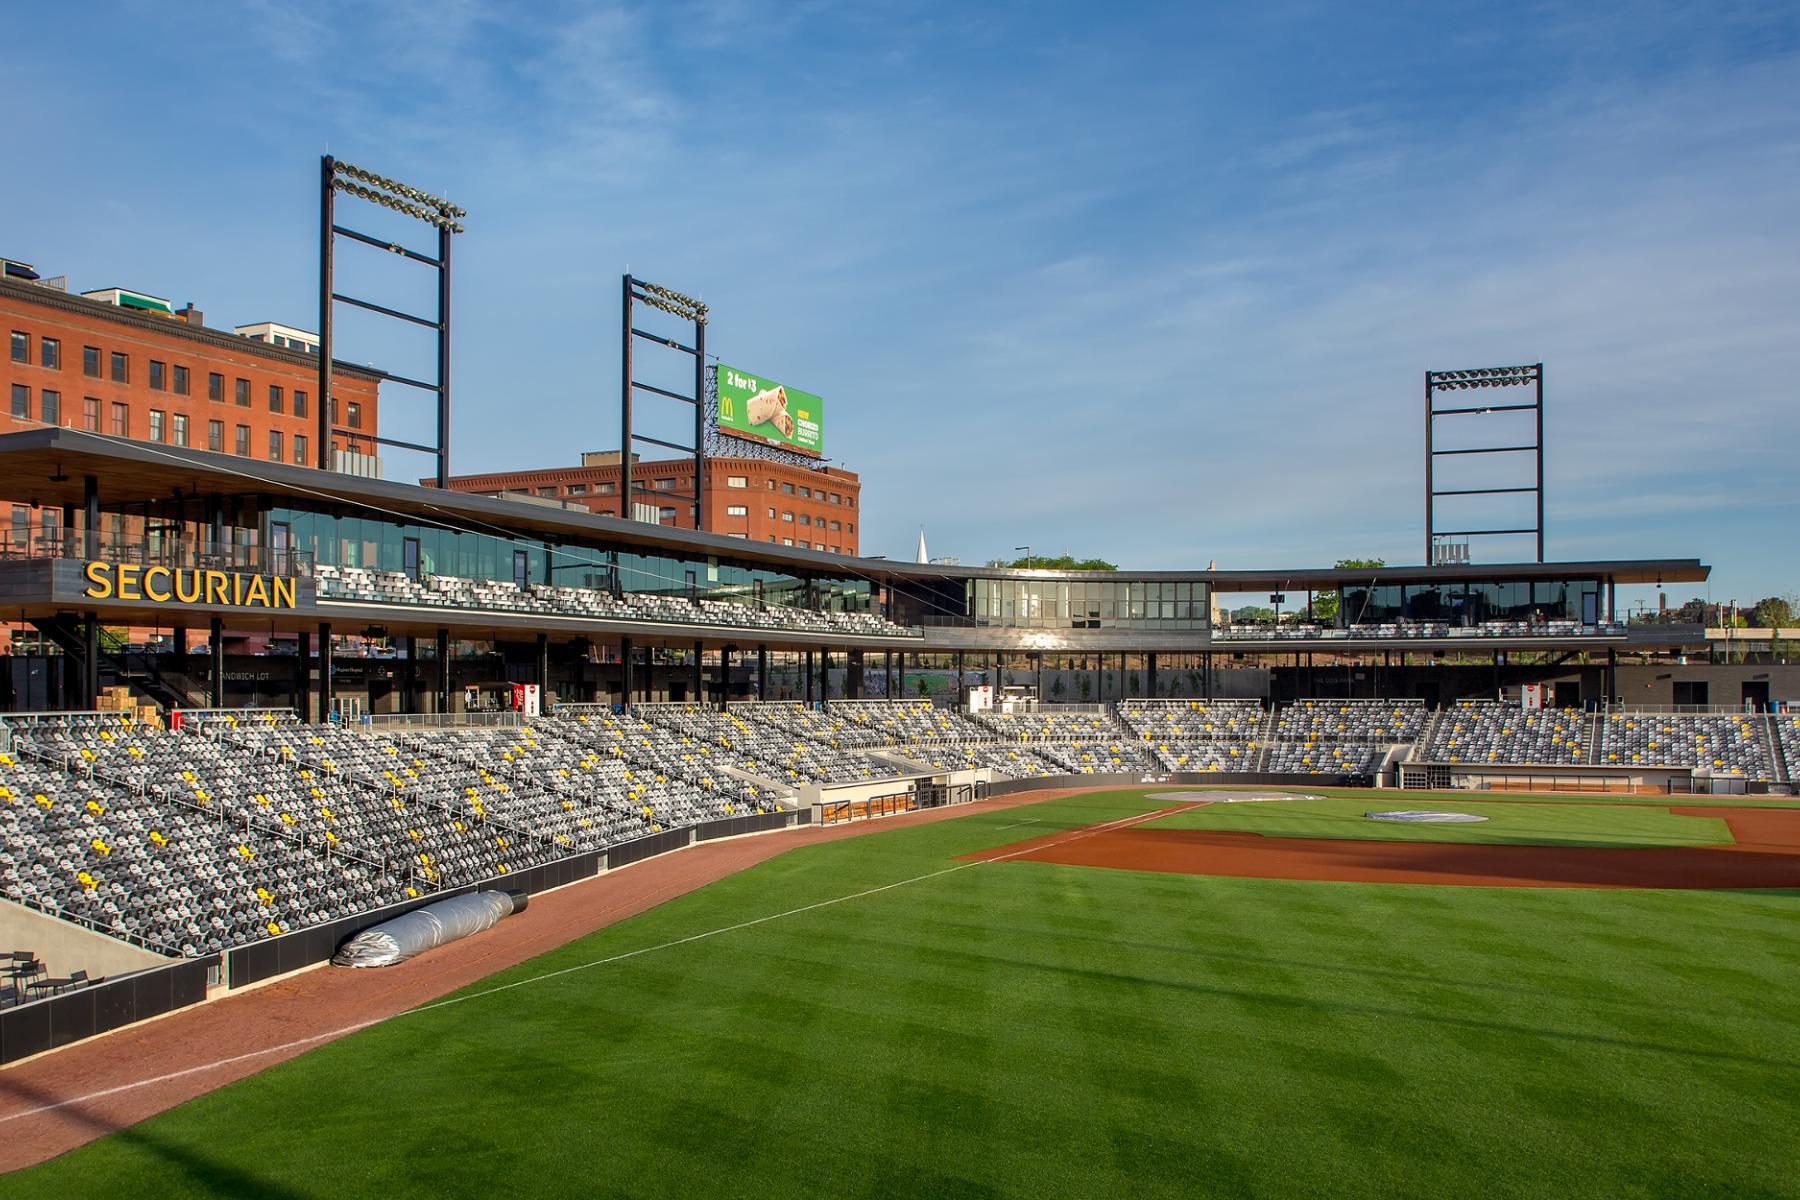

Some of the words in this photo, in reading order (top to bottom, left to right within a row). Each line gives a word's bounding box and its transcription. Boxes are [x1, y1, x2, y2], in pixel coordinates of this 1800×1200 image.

[728, 371, 734, 386] 2
[735, 374, 747, 390] for
[86, 561, 296, 609] SECURIAN
[220, 672, 255, 681] ANDWICH
[256, 672, 270, 681] LOT
